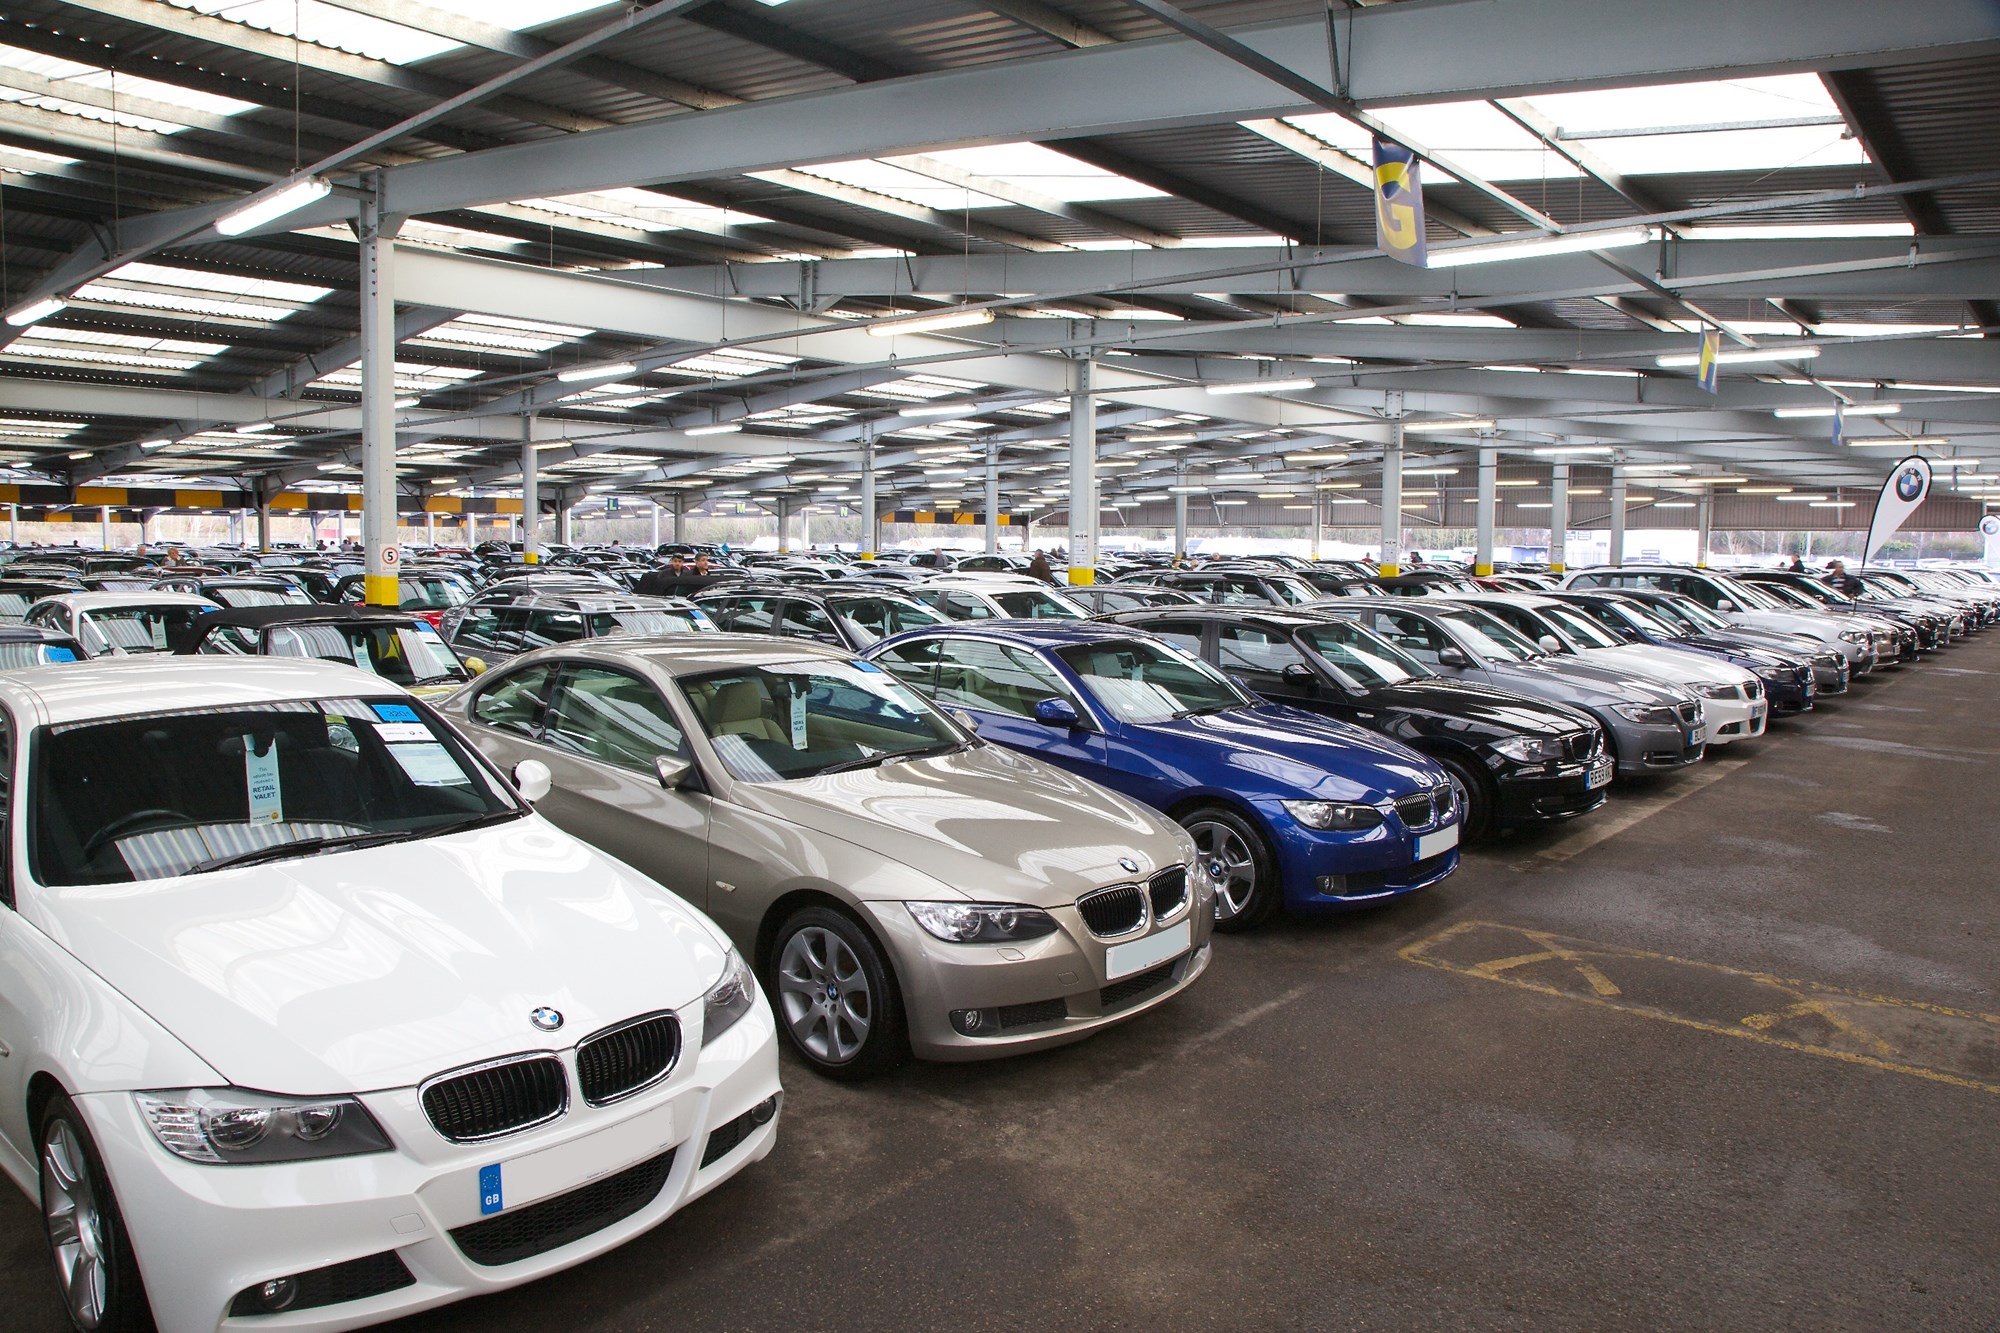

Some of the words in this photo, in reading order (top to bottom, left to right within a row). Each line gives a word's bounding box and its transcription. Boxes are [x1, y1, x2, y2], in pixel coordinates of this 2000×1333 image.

[1376, 162, 1417, 249] G
[387, 551, 394, 561] 5
[253, 784, 276, 793] RETAIL
[254, 791, 276, 800] VALET
[486, 1193, 499, 1205] GB
